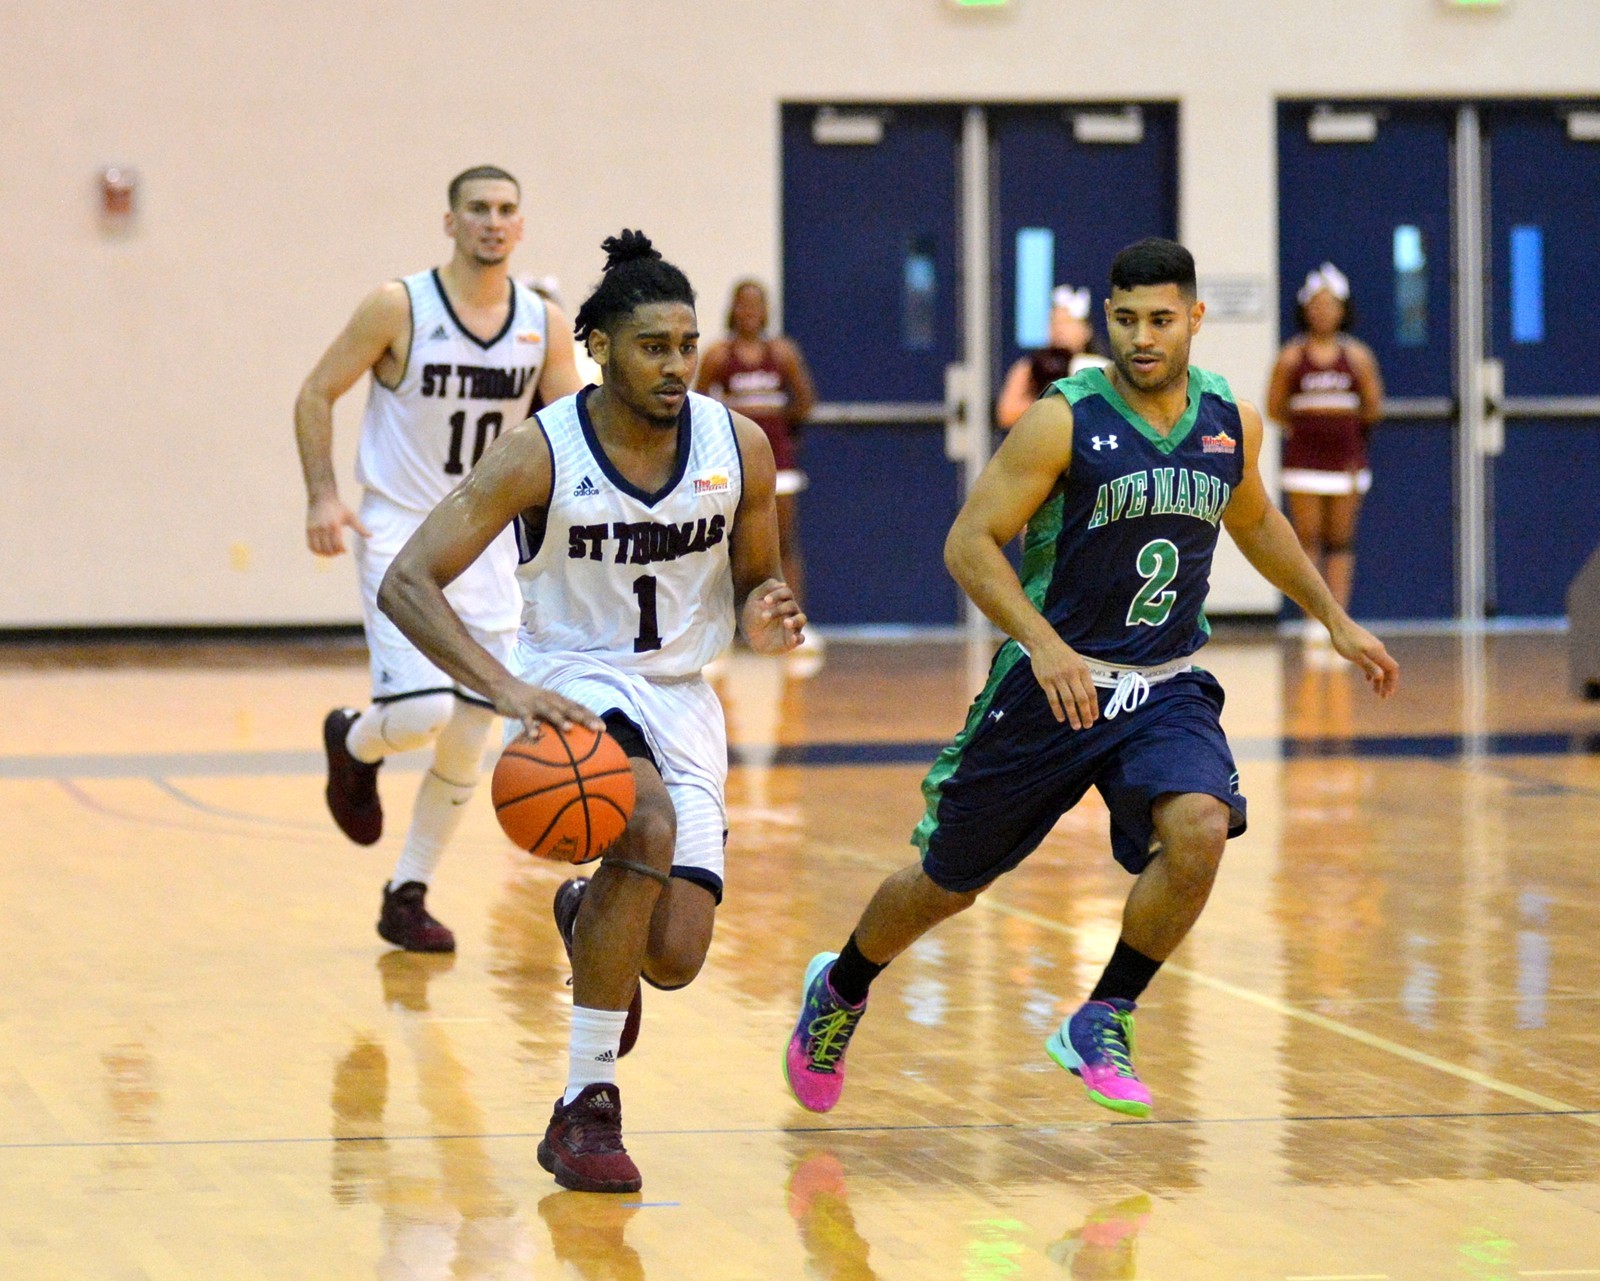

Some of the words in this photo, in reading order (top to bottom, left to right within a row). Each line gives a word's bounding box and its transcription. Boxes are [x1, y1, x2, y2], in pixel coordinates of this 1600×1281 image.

[421, 364, 452, 398] ST
[444, 411, 503, 475] 10
[573, 487, 599, 497] adidas
[1088, 470, 1148, 529] AVE
[568, 523, 608, 562] ST
[1125, 538, 1179, 626] 2
[633, 575, 663, 653] 1
